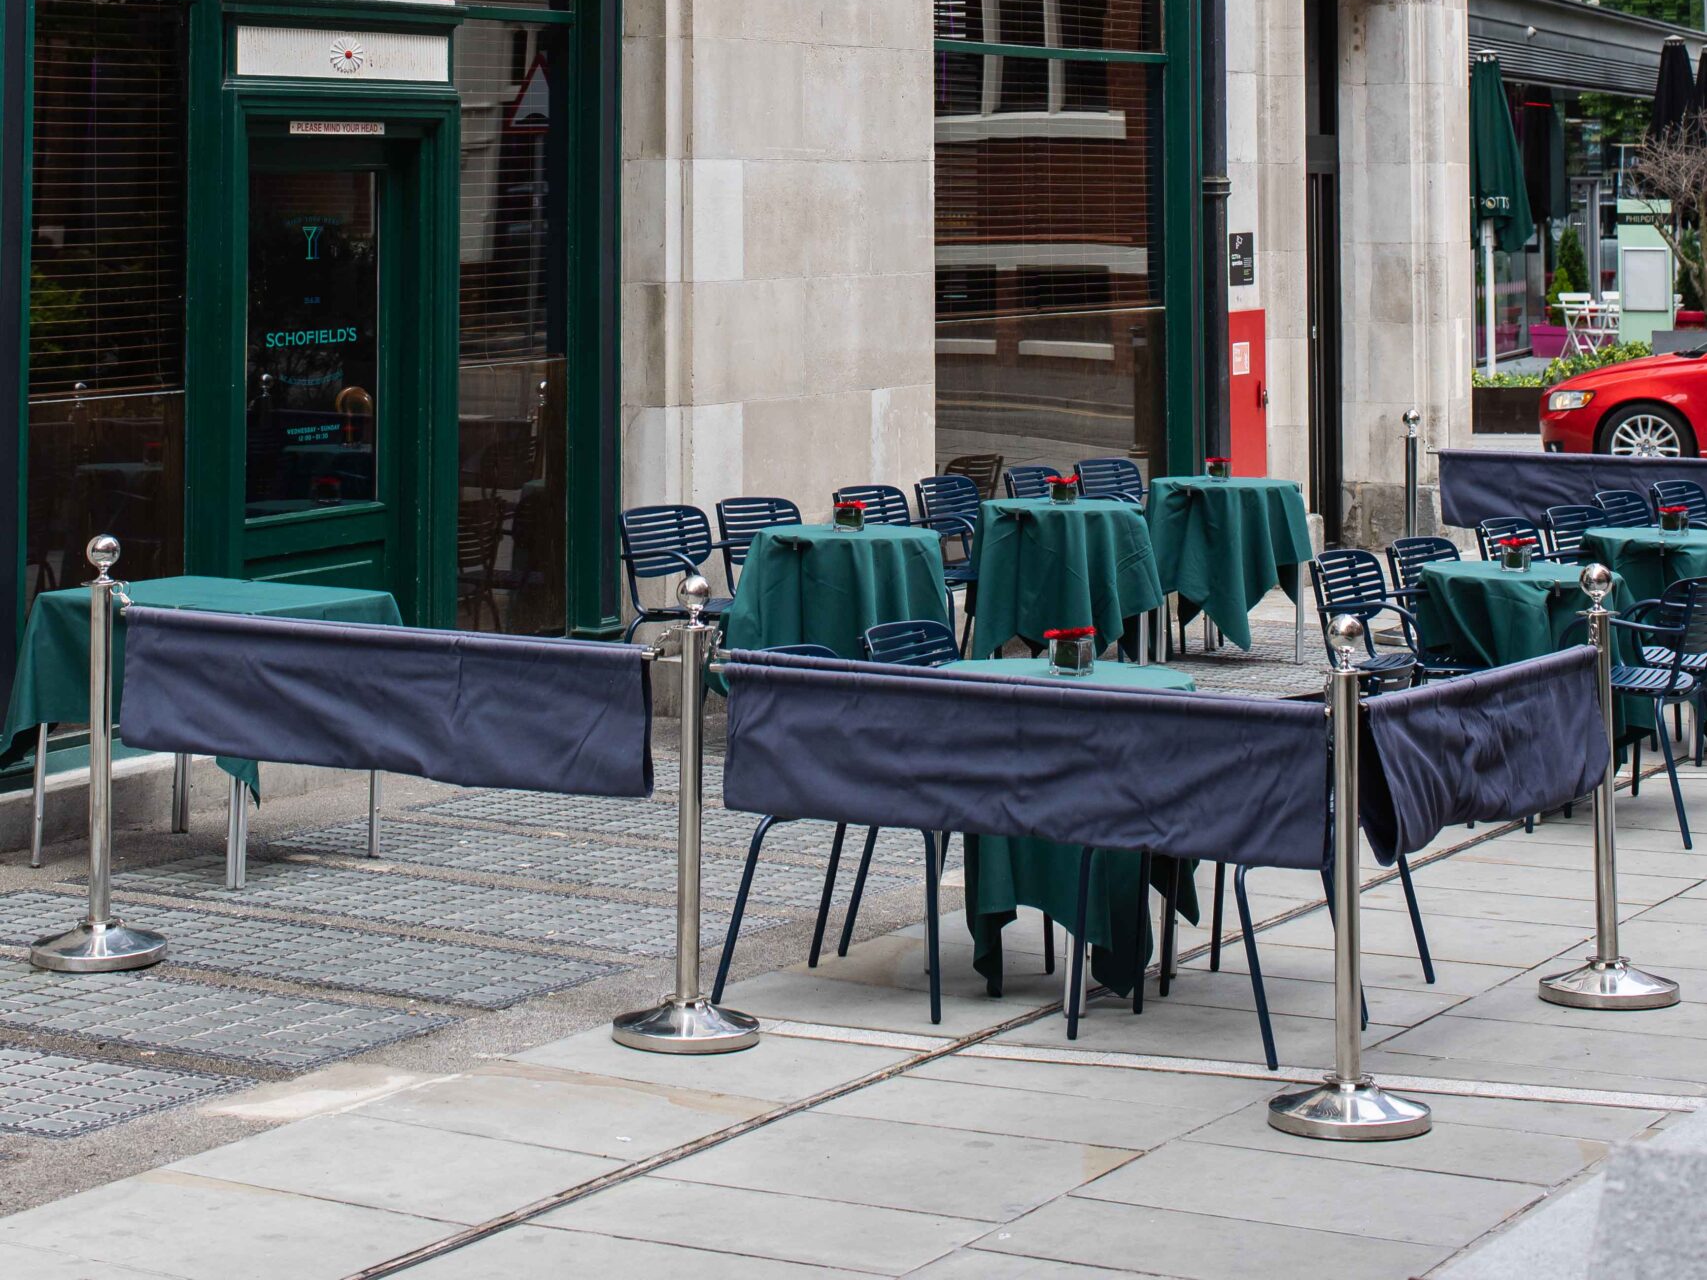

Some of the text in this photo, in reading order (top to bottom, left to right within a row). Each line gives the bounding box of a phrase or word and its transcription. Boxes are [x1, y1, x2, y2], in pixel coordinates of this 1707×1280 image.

[296, 122, 378, 133] PLEASE MIND YOUR HEAD
[265, 327, 357, 349] SCHOFIELD'S
